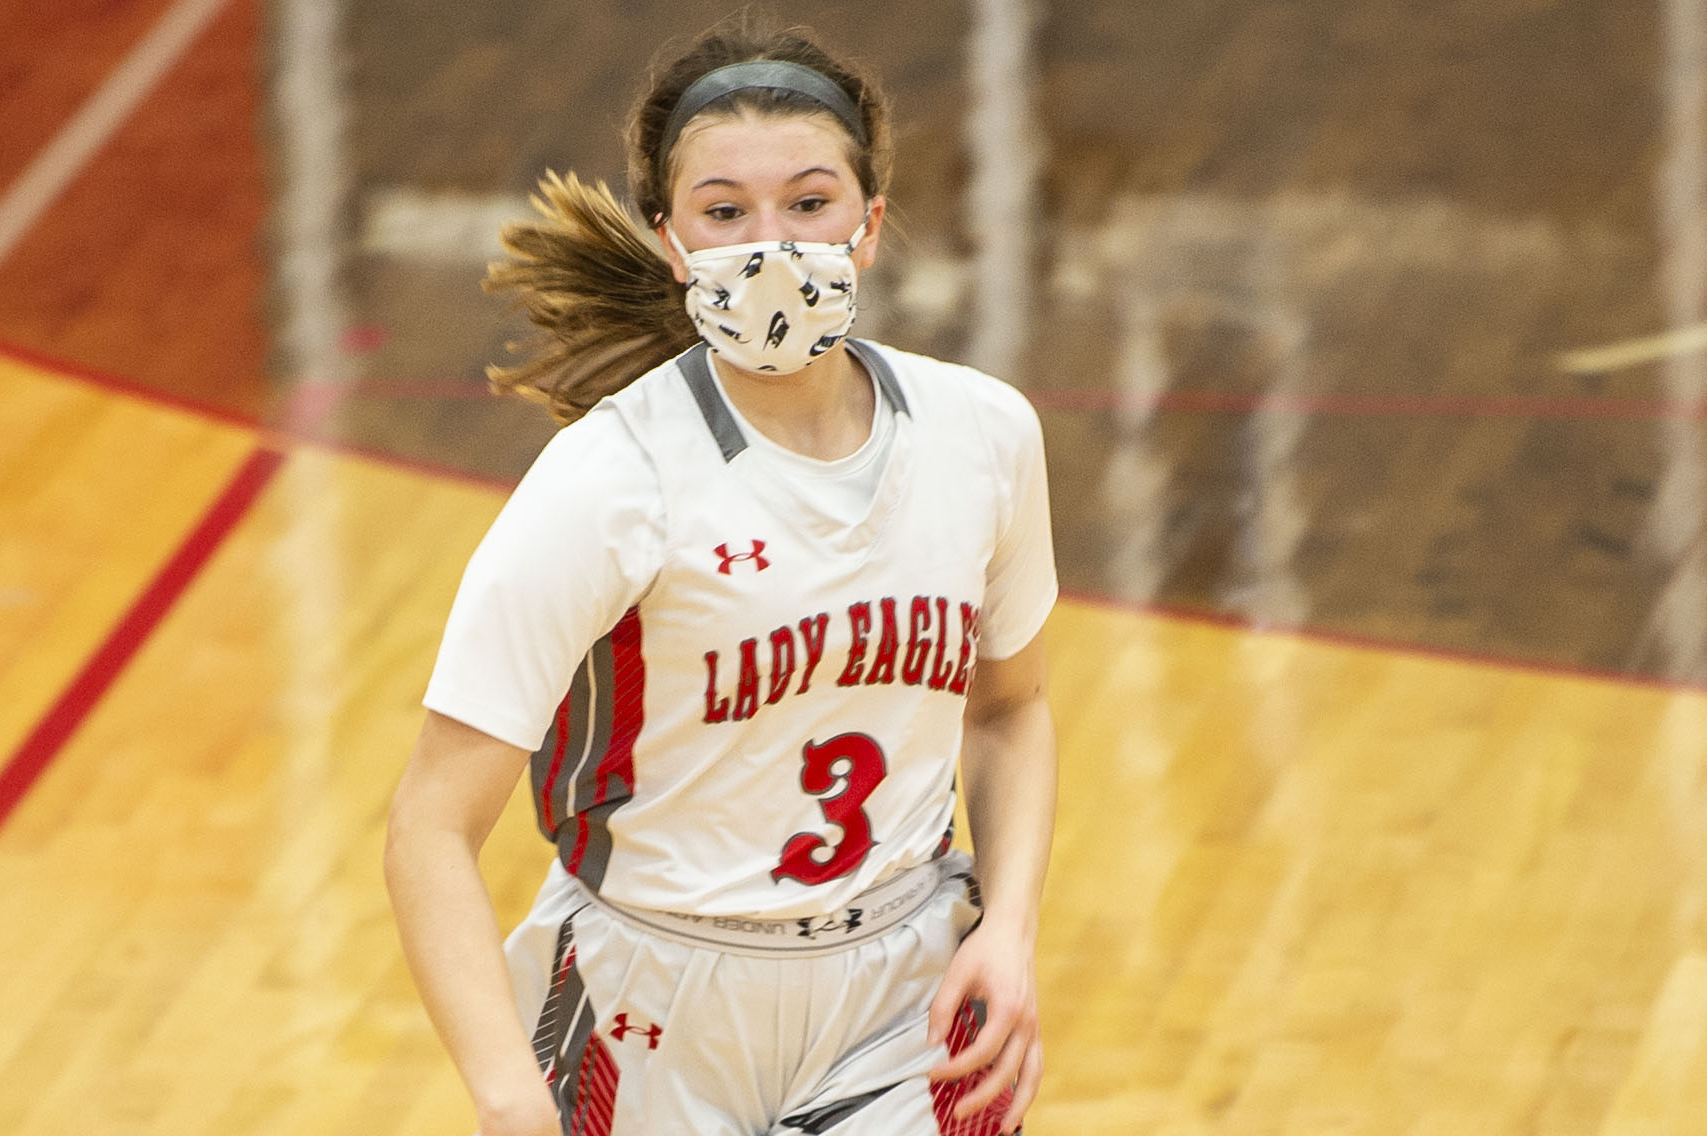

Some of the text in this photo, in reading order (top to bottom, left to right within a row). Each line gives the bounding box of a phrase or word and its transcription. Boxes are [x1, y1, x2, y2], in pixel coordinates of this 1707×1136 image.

[703, 595, 981, 724] LADY EAGLE
[770, 731, 888, 887] 3
[712, 916, 787, 935] UNDER
